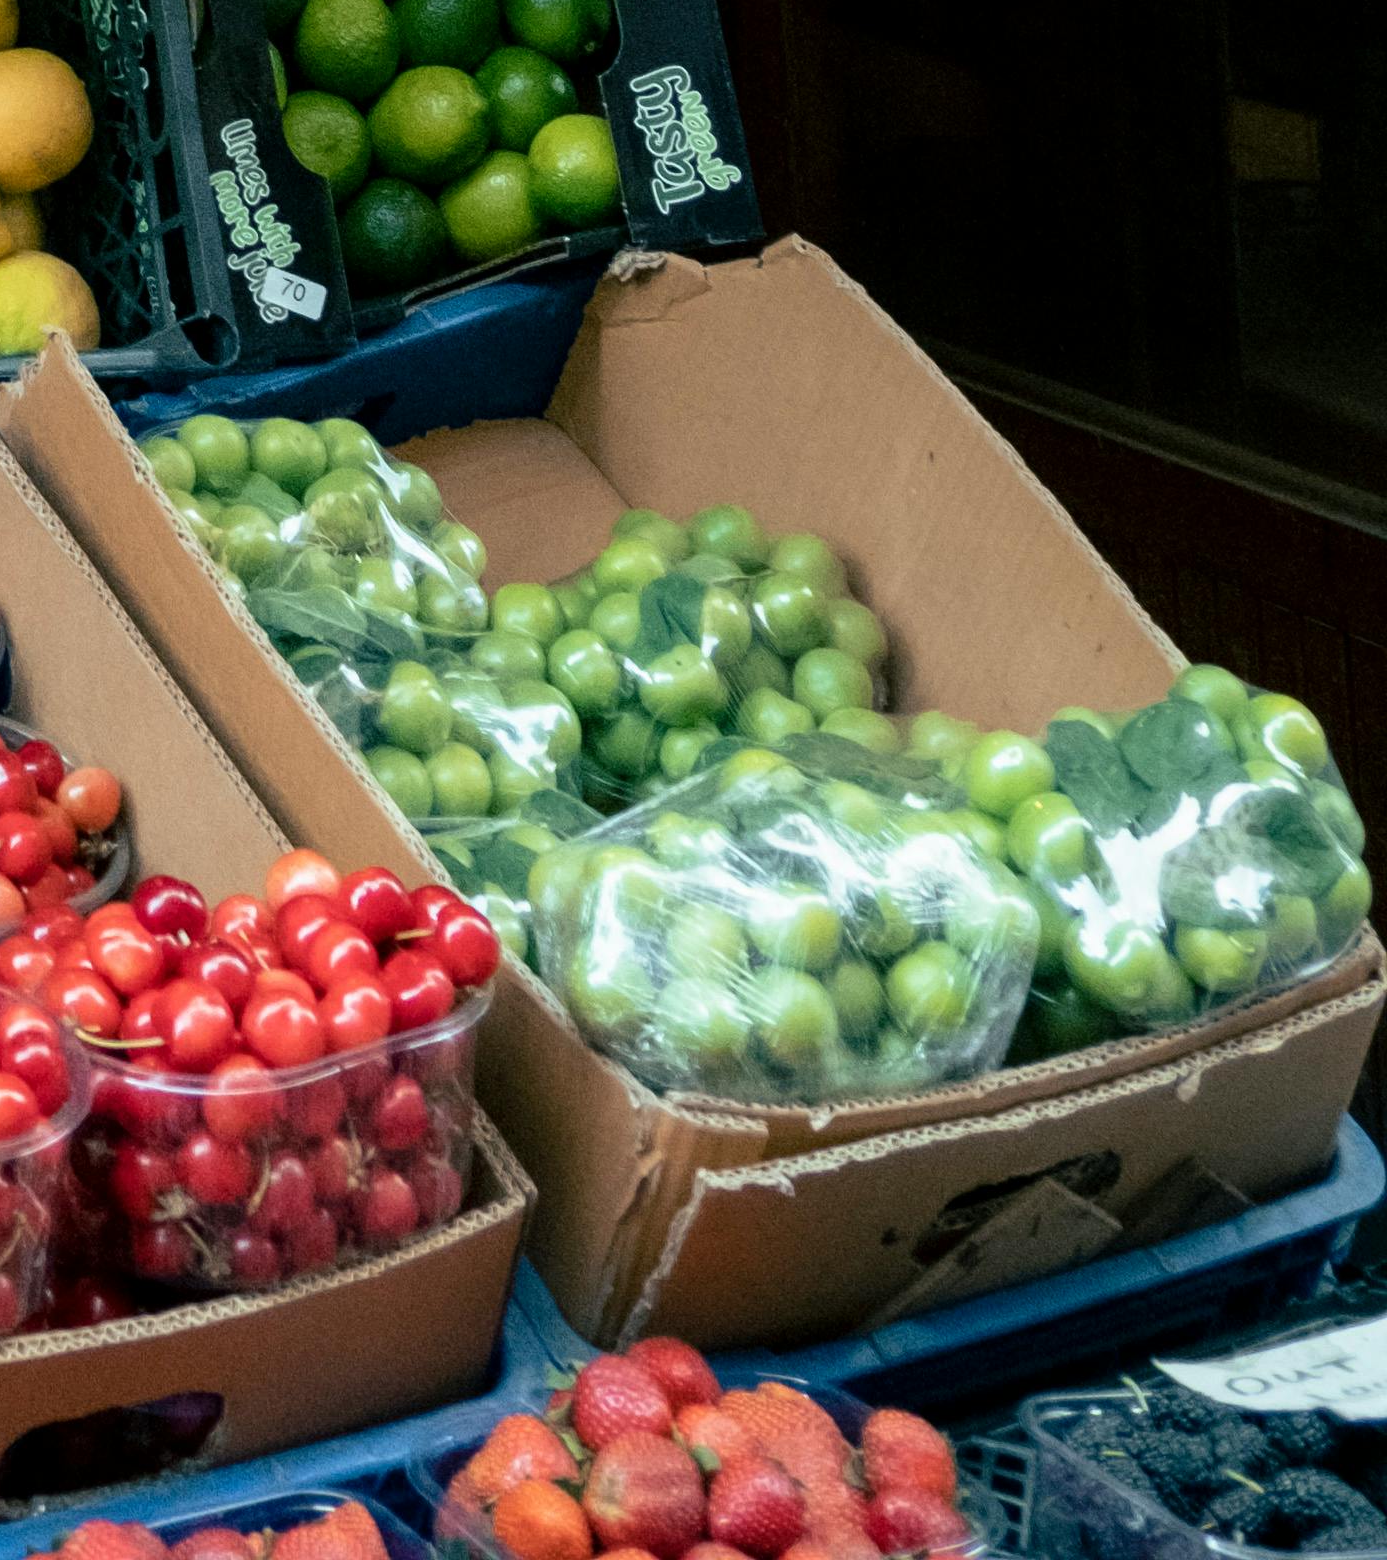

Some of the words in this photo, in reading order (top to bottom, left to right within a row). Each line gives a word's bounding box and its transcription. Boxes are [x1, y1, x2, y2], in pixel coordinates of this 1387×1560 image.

[629, 64, 706, 215] Tasty
[678, 90, 742, 191] green
[208, 169, 259, 249] more
[280, 276, 307, 303] 70
